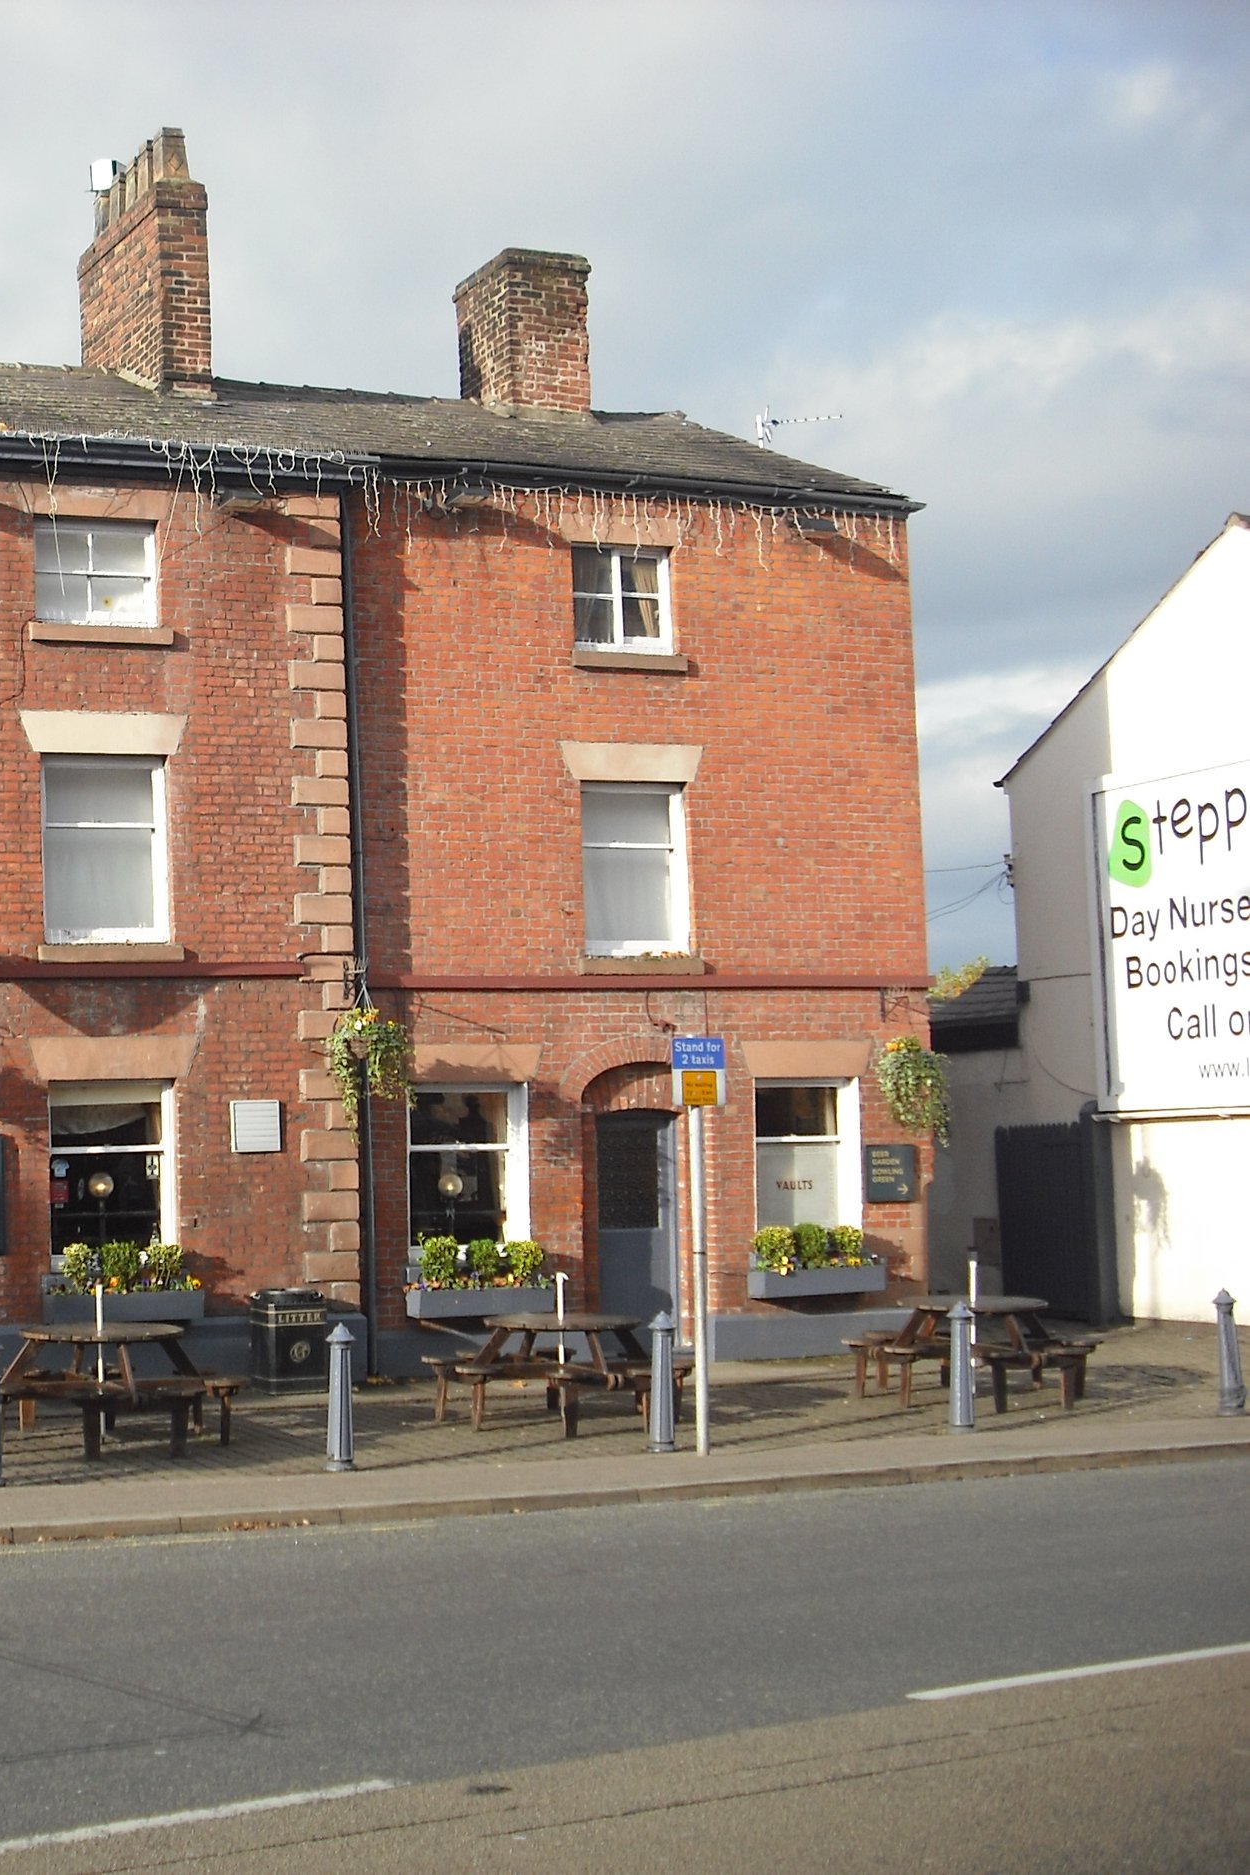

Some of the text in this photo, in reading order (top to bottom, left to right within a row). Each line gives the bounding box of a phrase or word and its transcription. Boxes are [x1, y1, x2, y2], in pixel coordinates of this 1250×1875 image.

[1110, 906, 1160, 941] Day
[1126, 948, 1250, 989] Bookings
[1167, 1004, 1250, 1040] Call o
[674, 1042, 721, 1052] Stand for
[681, 1054, 715, 1065] 2 taxis
[776, 1180, 814, 1191] VAULTS
[278, 1313, 321, 1324] LITTER
